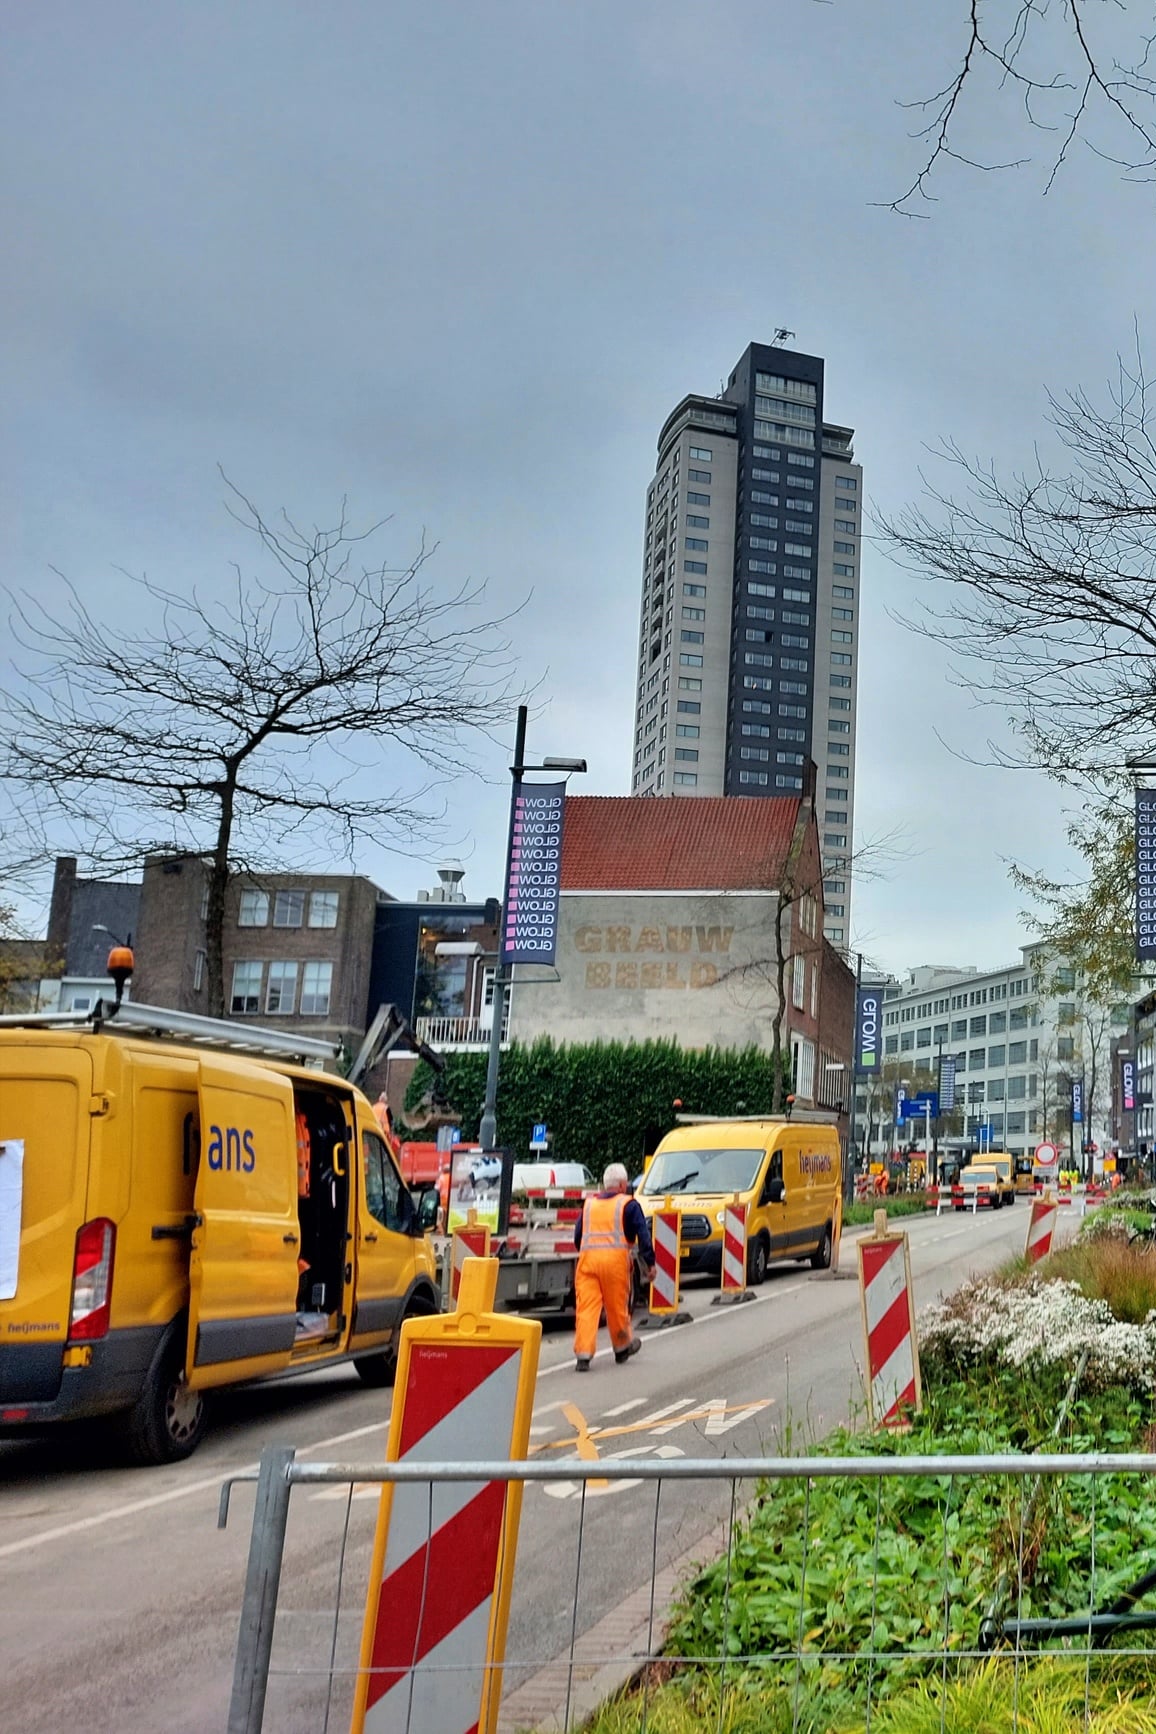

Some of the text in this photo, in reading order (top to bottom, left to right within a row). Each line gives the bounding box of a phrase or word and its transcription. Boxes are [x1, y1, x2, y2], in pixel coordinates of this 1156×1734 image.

[574, 925, 735, 953] GRAUW
[584, 961, 718, 989] BEELD
[1123, 1063, 1133, 1100] GLOW
